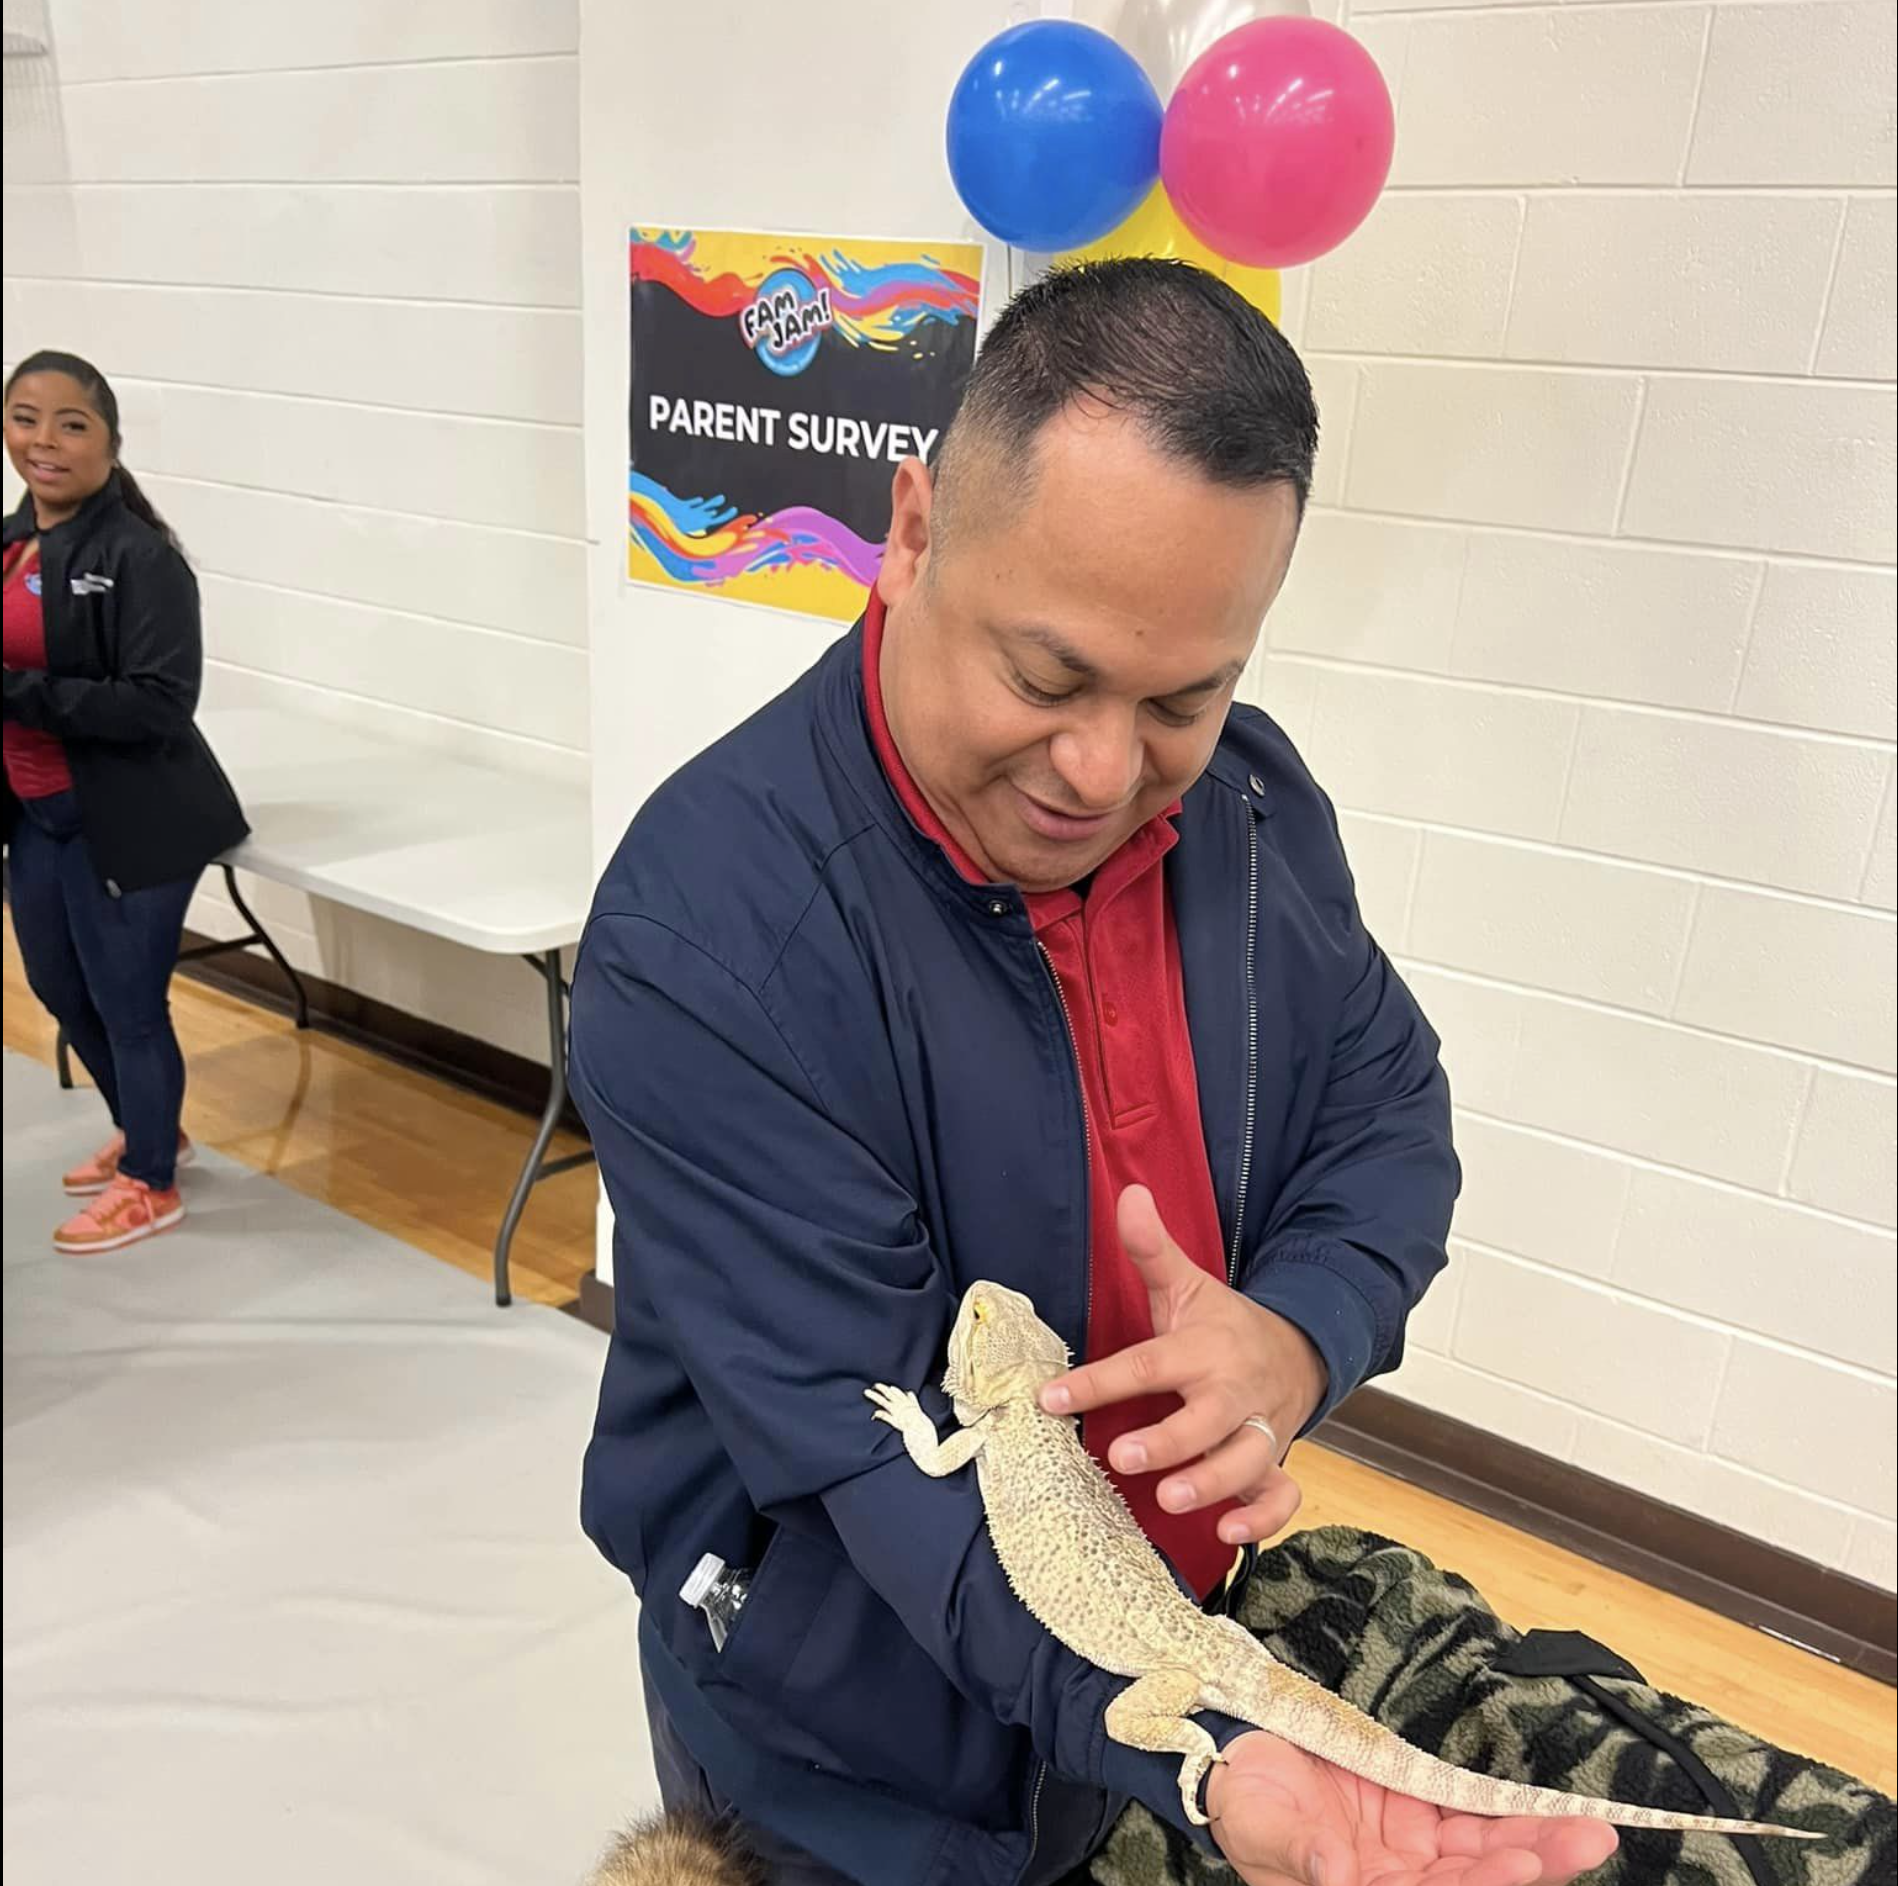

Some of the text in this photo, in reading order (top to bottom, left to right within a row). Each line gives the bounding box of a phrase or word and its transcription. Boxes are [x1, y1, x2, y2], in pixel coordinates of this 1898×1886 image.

[743, 290, 796, 339] FAM
[773, 290, 830, 349] JAM!
[649, 395, 939, 465] PARENT SURVEY
